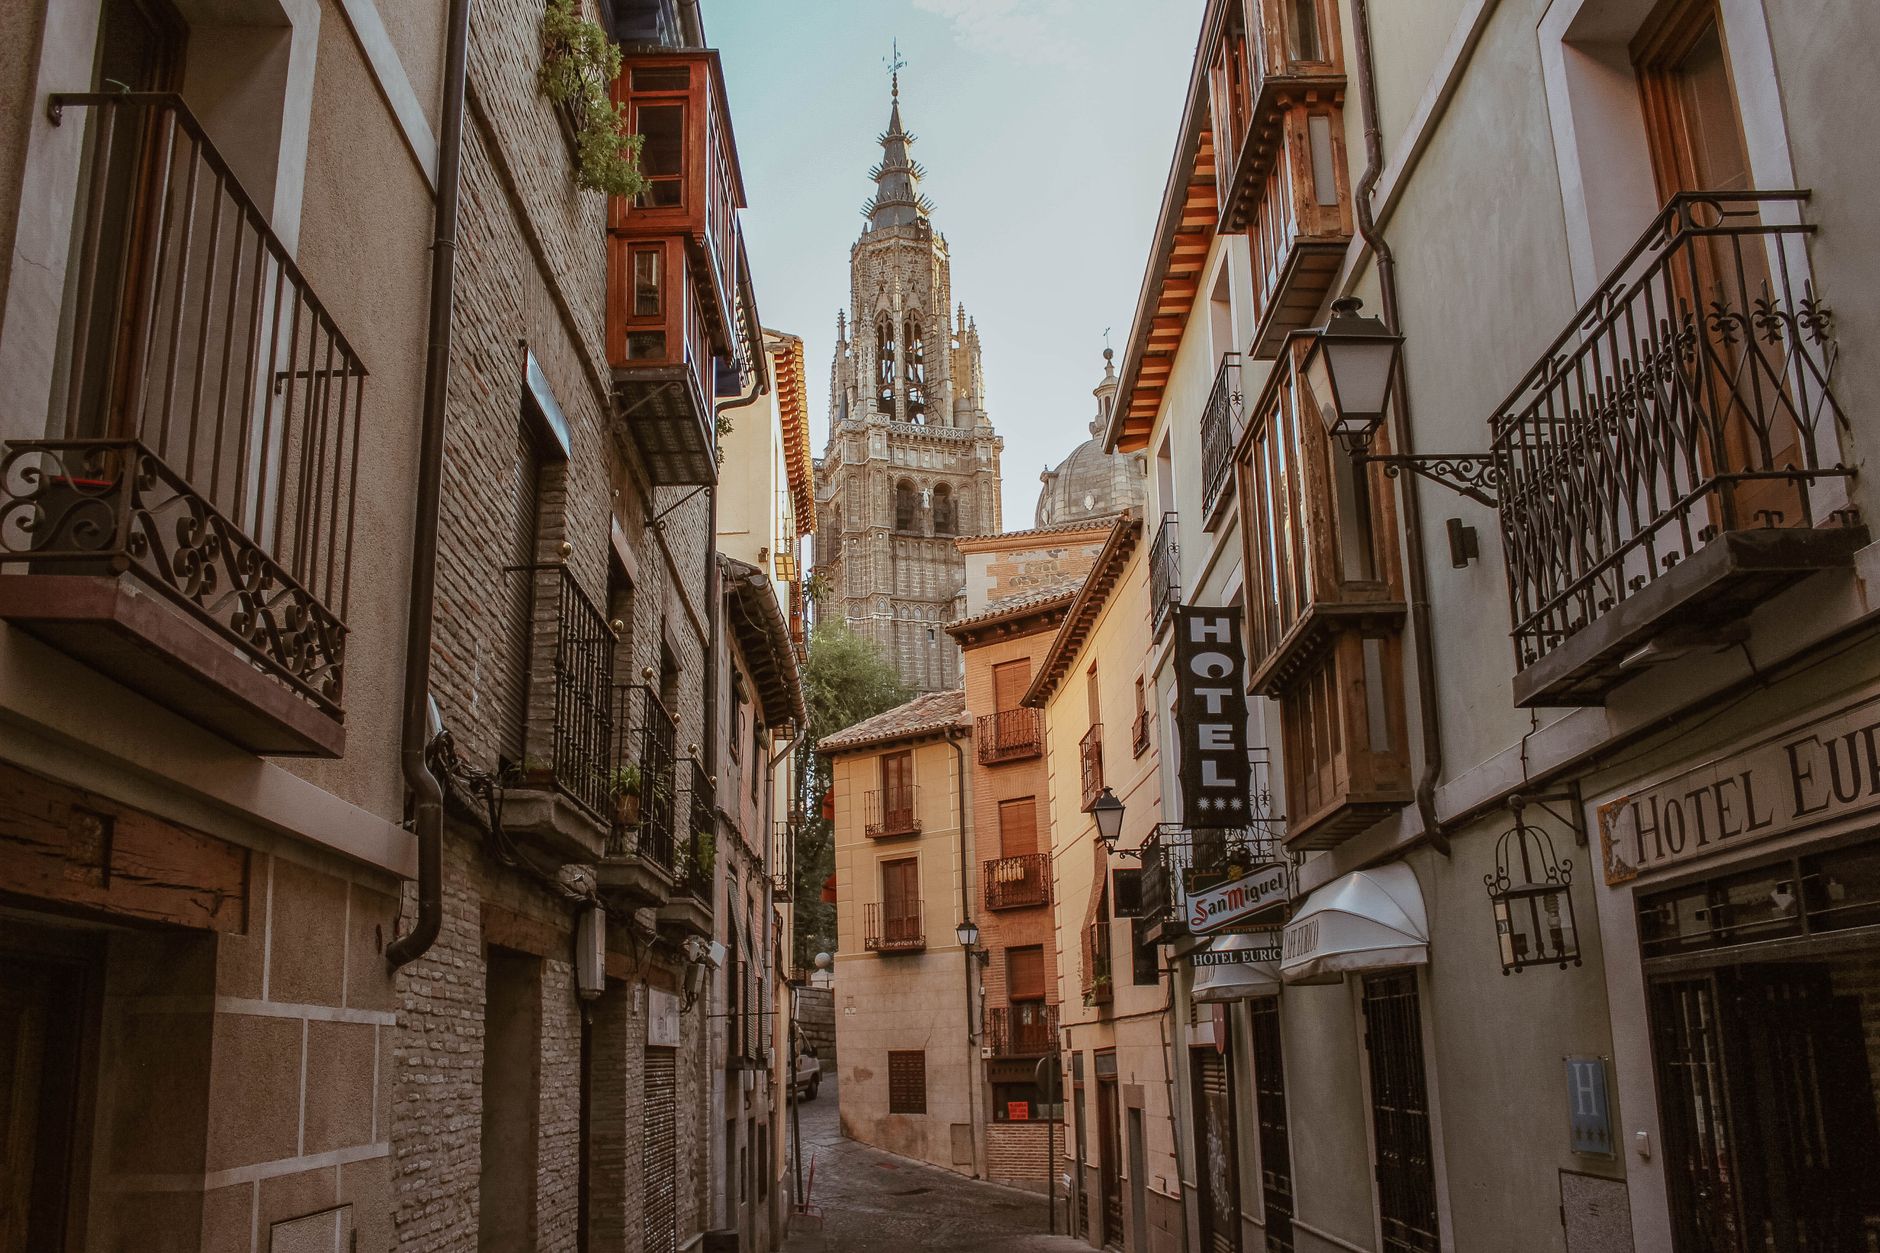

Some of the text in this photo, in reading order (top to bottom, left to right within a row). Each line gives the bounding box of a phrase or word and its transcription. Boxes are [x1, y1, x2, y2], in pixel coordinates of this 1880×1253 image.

[1190, 617, 1236, 787] HOTEL
[1631, 769, 1775, 864] HOTEL
[1193, 948, 1281, 966] HOTEL EURIC
[1572, 1063, 1599, 1116] H
